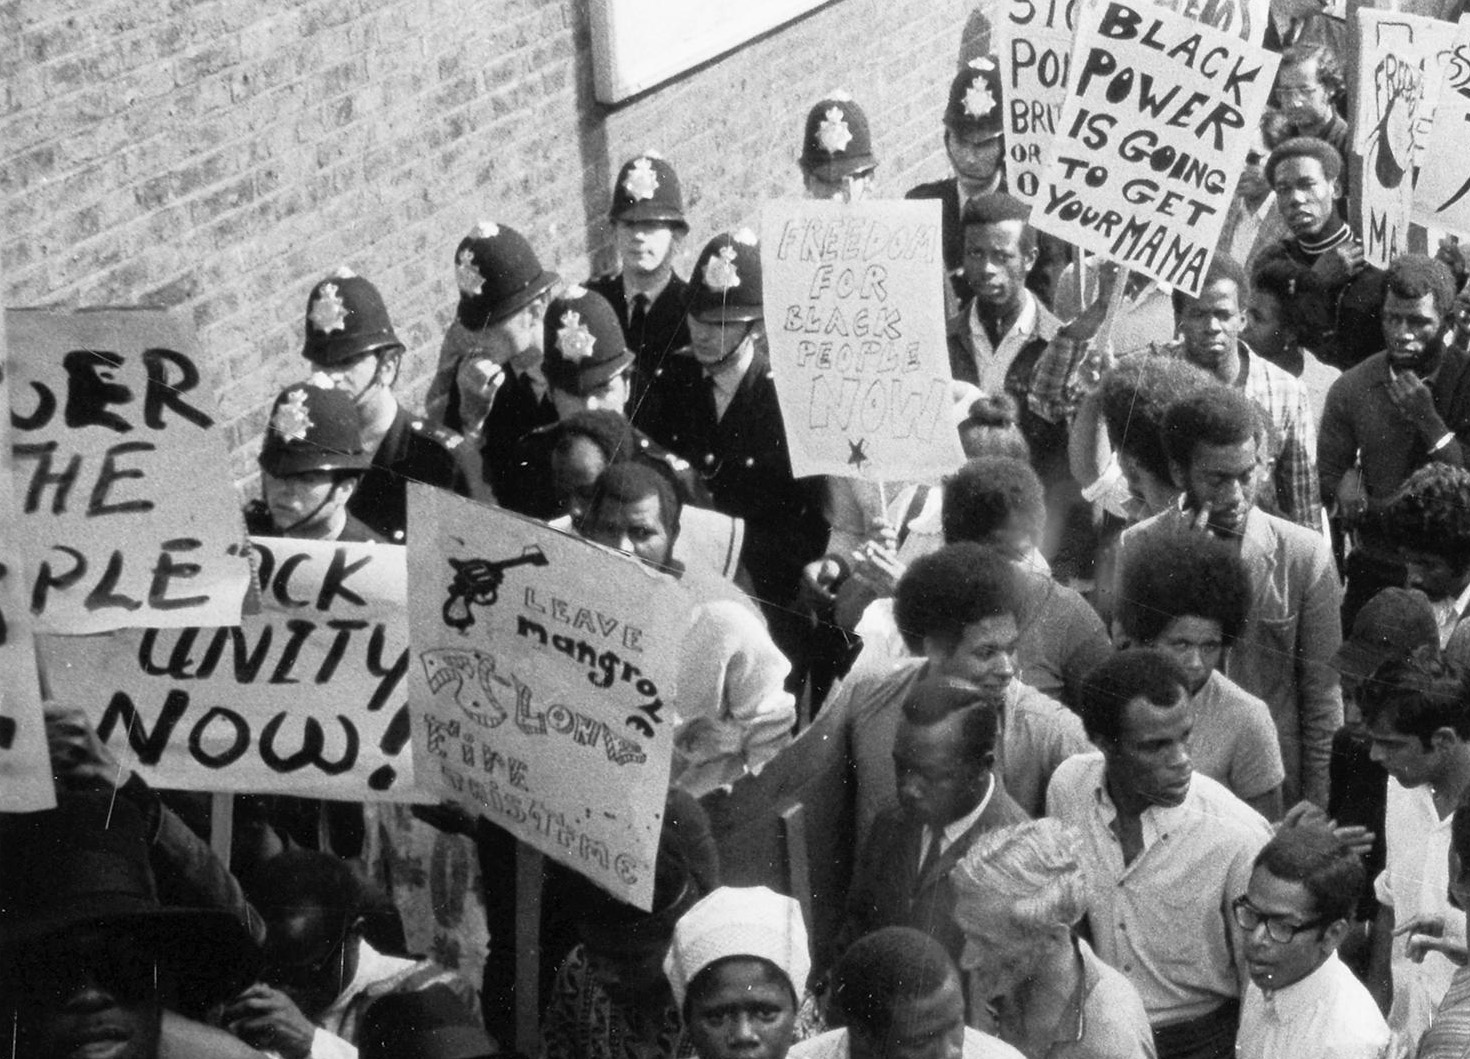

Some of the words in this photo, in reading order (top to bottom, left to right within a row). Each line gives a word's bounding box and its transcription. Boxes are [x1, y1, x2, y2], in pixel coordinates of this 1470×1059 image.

[1098, 2, 1263, 107] BLACK
[1076, 48, 1245, 151] POWER
[1011, 143, 1041, 165] OR
[1068, 108, 1118, 150] IS
[1118, 130, 1227, 195] GOING
[1057, 156, 1108, 187] TO
[1122, 178, 1217, 226] GET
[777, 217, 936, 263] FREEDOM
[1044, 184, 1123, 238] YOUR
[1109, 215, 1209, 293] MAMA
[809, 264, 888, 302] FOR
[784, 304, 902, 340] BLACK
[797, 340, 920, 374] PEOPLE
[809, 374, 947, 443] NOW
[12, 441, 156, 516] THE
[525, 587, 644, 652] LEAVE
[139, 619, 410, 711] UNITY
[517, 615, 664, 739] mangrove
[97, 689, 411, 791] NOW!
